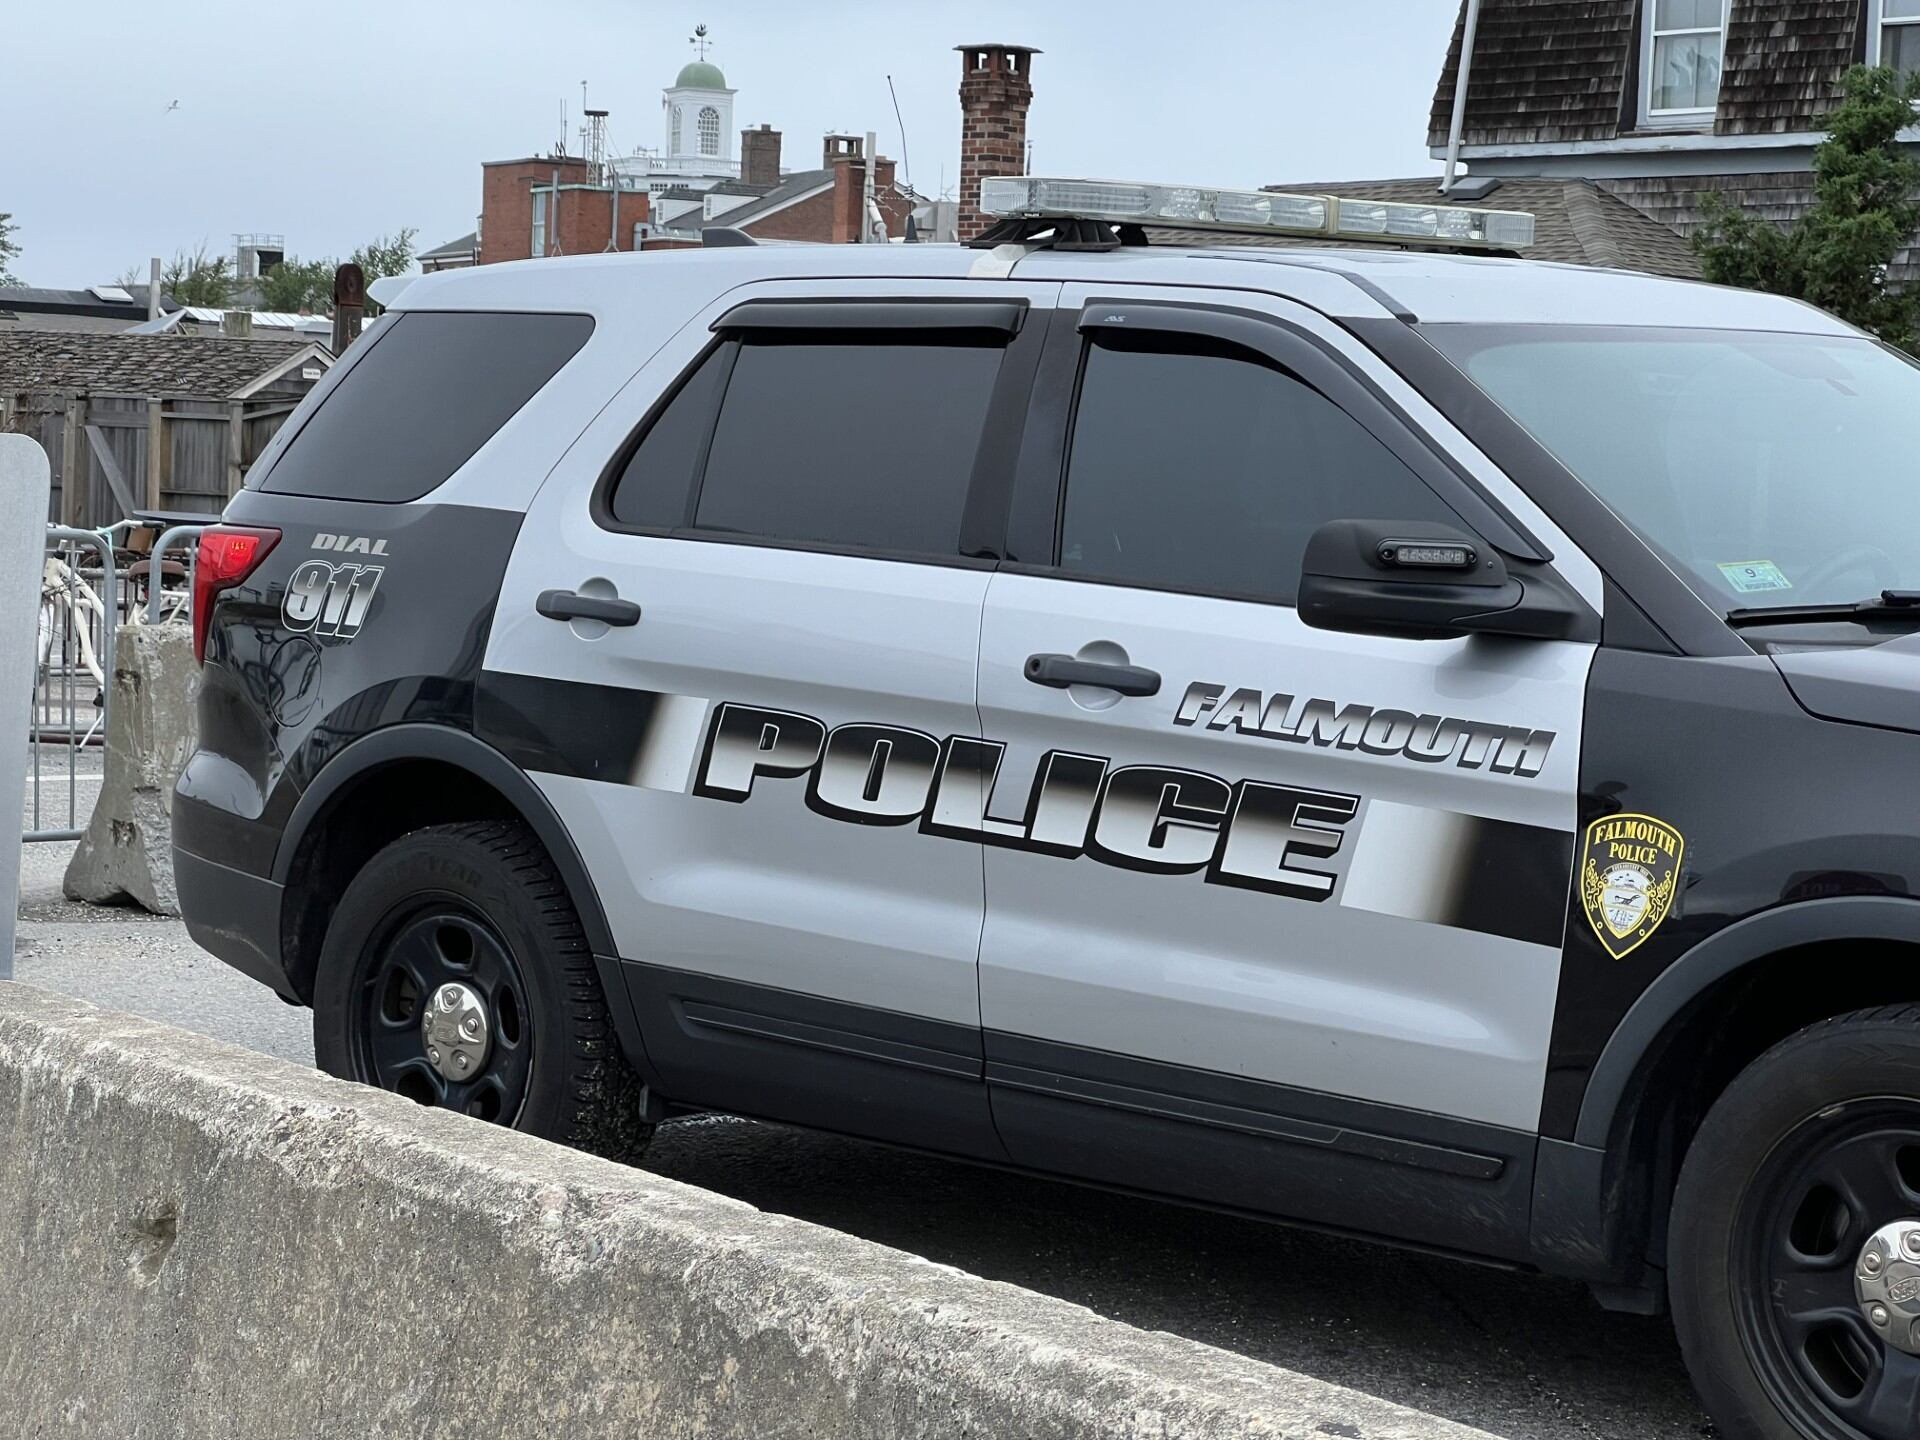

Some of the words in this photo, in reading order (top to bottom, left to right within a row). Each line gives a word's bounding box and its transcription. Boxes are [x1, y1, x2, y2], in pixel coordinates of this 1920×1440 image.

[311, 532, 390, 556] DIAL
[1744, 568, 1757, 578] 9
[281, 559, 386, 639] 911
[1173, 681, 1557, 779] FALMOUTH
[692, 701, 1362, 903] POLICE
[1594, 820, 1677, 858] FALMOUTH
[1608, 842, 1659, 865] POLICE
